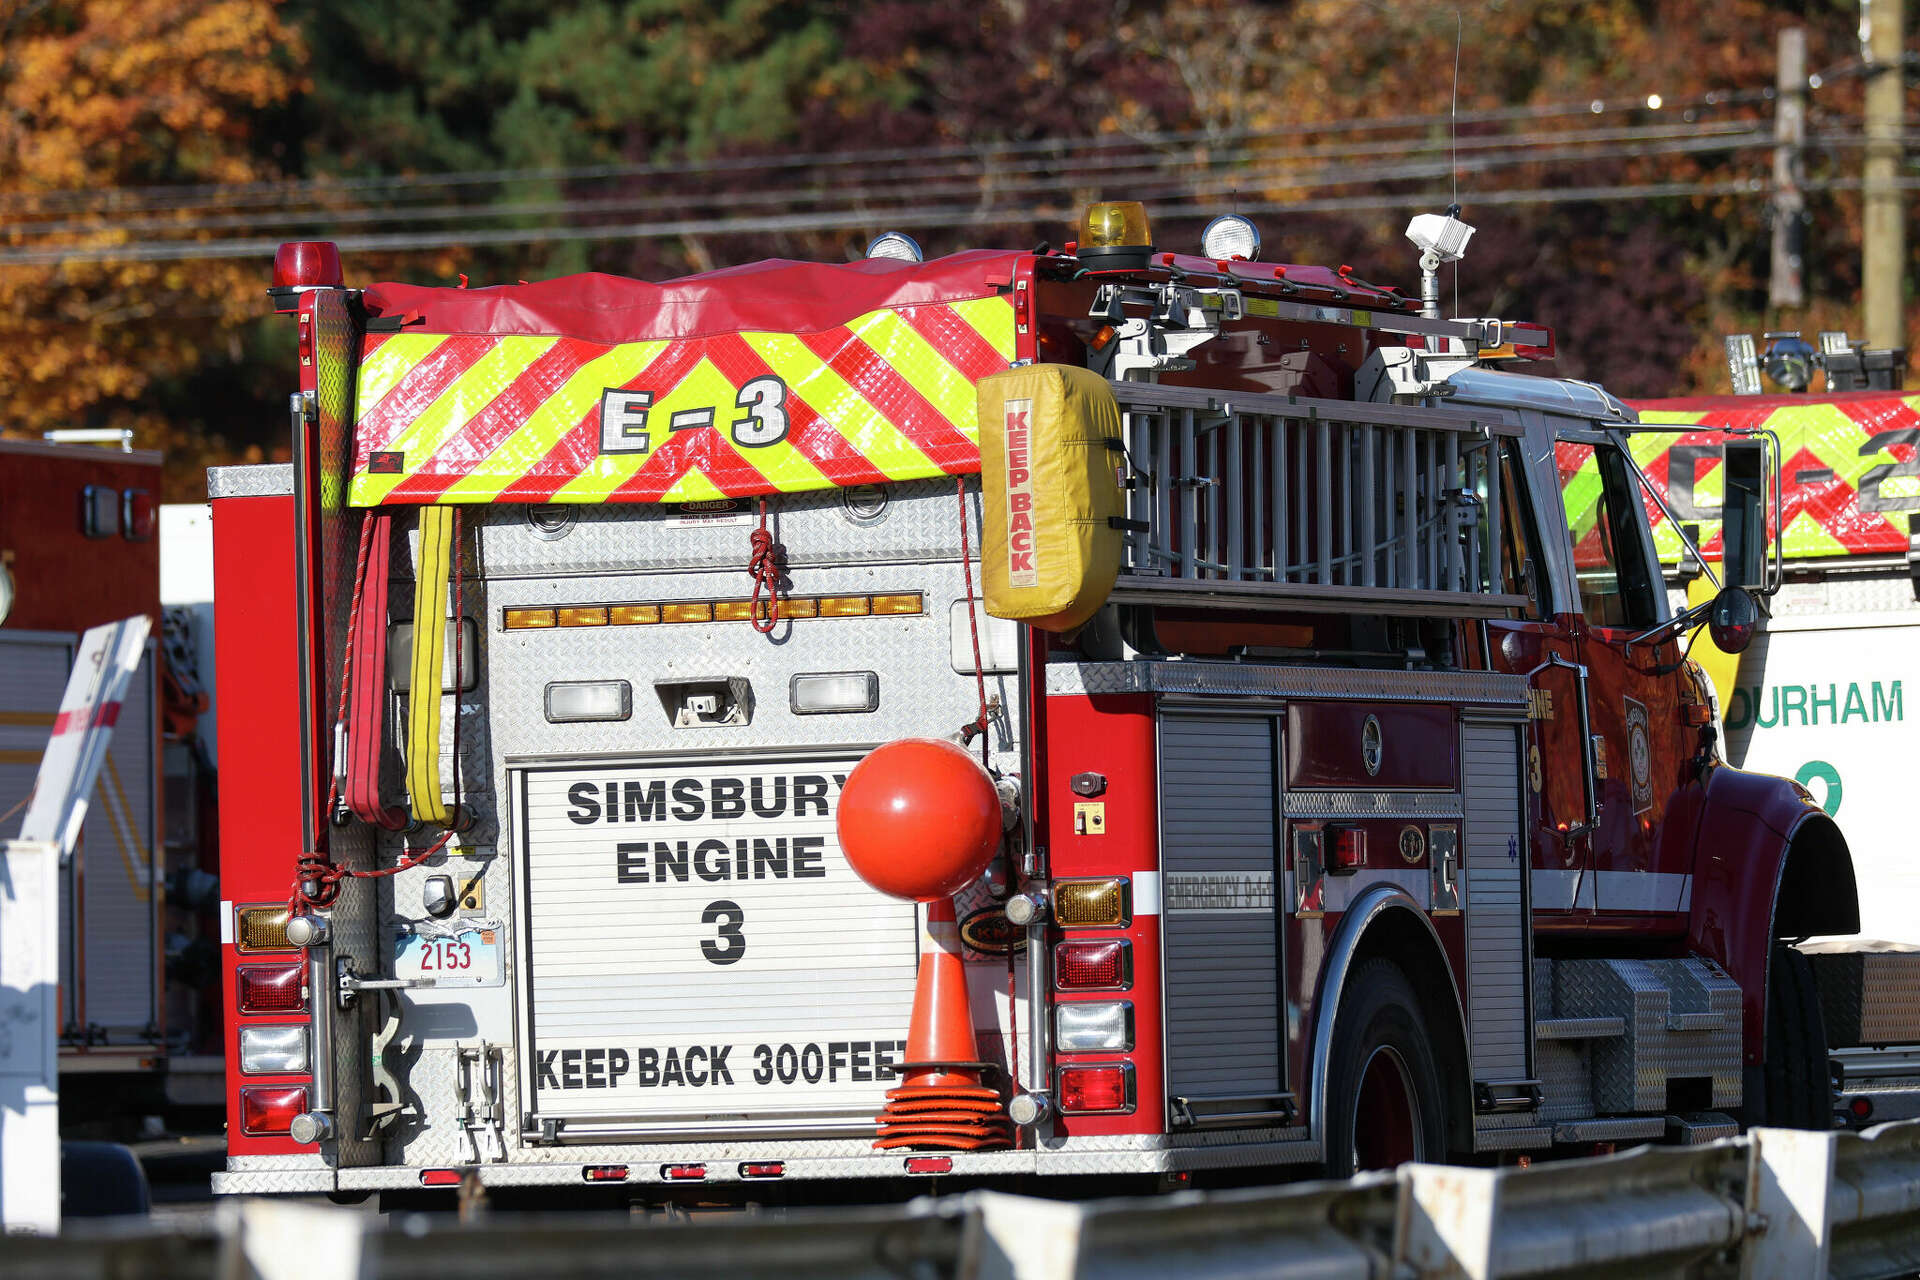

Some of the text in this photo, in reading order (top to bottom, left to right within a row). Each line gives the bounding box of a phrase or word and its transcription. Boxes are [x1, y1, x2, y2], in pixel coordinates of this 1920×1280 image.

[599, 374, 790, 455] E-3
[1007, 411, 1029, 488] KEEP
[688, 500, 729, 510] DANGER
[1010, 493, 1033, 571] BACK
[1725, 680, 1904, 730] DURHAM
[1529, 744, 1543, 793] 3
[567, 774, 850, 825] SIMSBUR
[616, 836, 827, 884] ENGINE
[1167, 876, 1240, 908] EMERGENCY
[420, 942, 472, 971] 2153
[699, 899, 747, 966] 3
[537, 1039, 907, 1090] KEEP BACK 300 FEE
